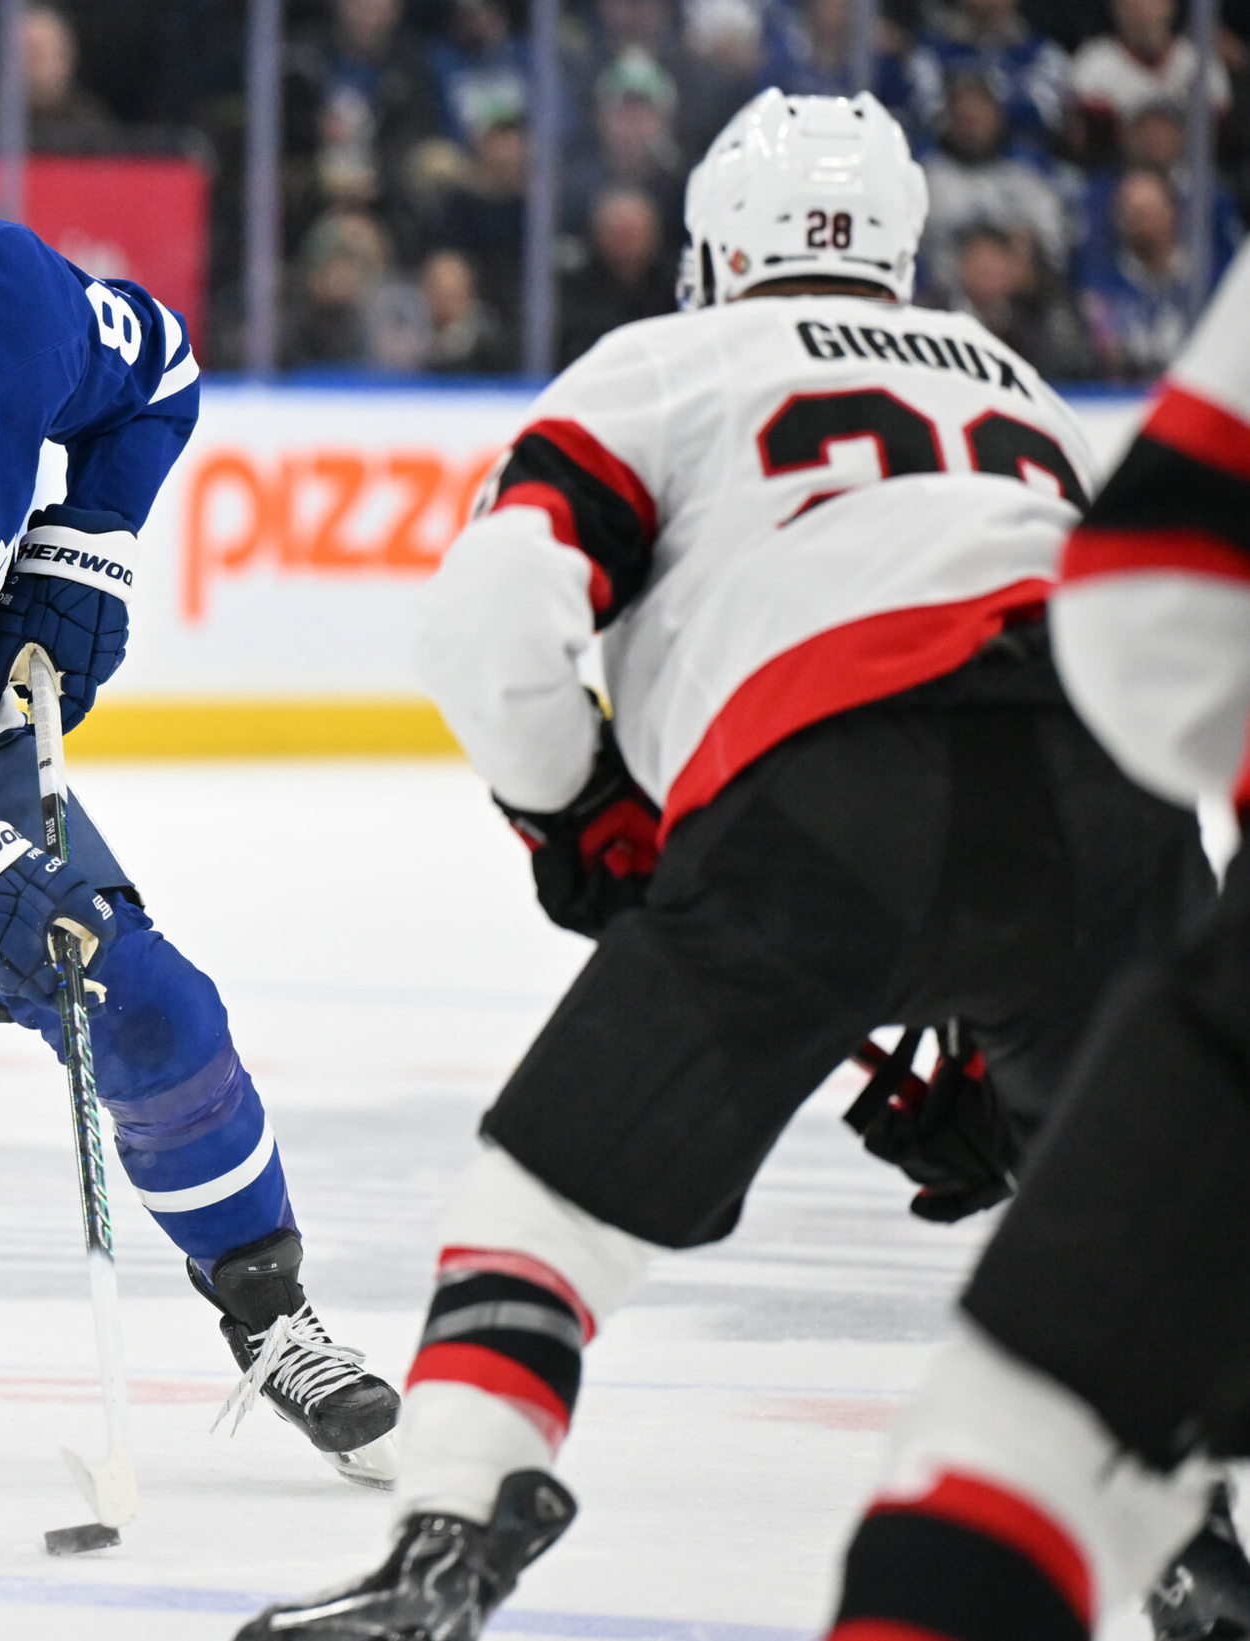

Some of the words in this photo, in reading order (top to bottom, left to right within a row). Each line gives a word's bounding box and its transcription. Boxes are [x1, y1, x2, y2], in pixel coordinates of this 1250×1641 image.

[806, 210, 853, 250] 28
[85, 277, 142, 366] 8
[796, 320, 1033, 402] GIROUX
[17, 542, 134, 587] HERWOO
[45, 817, 57, 846] STYLES
